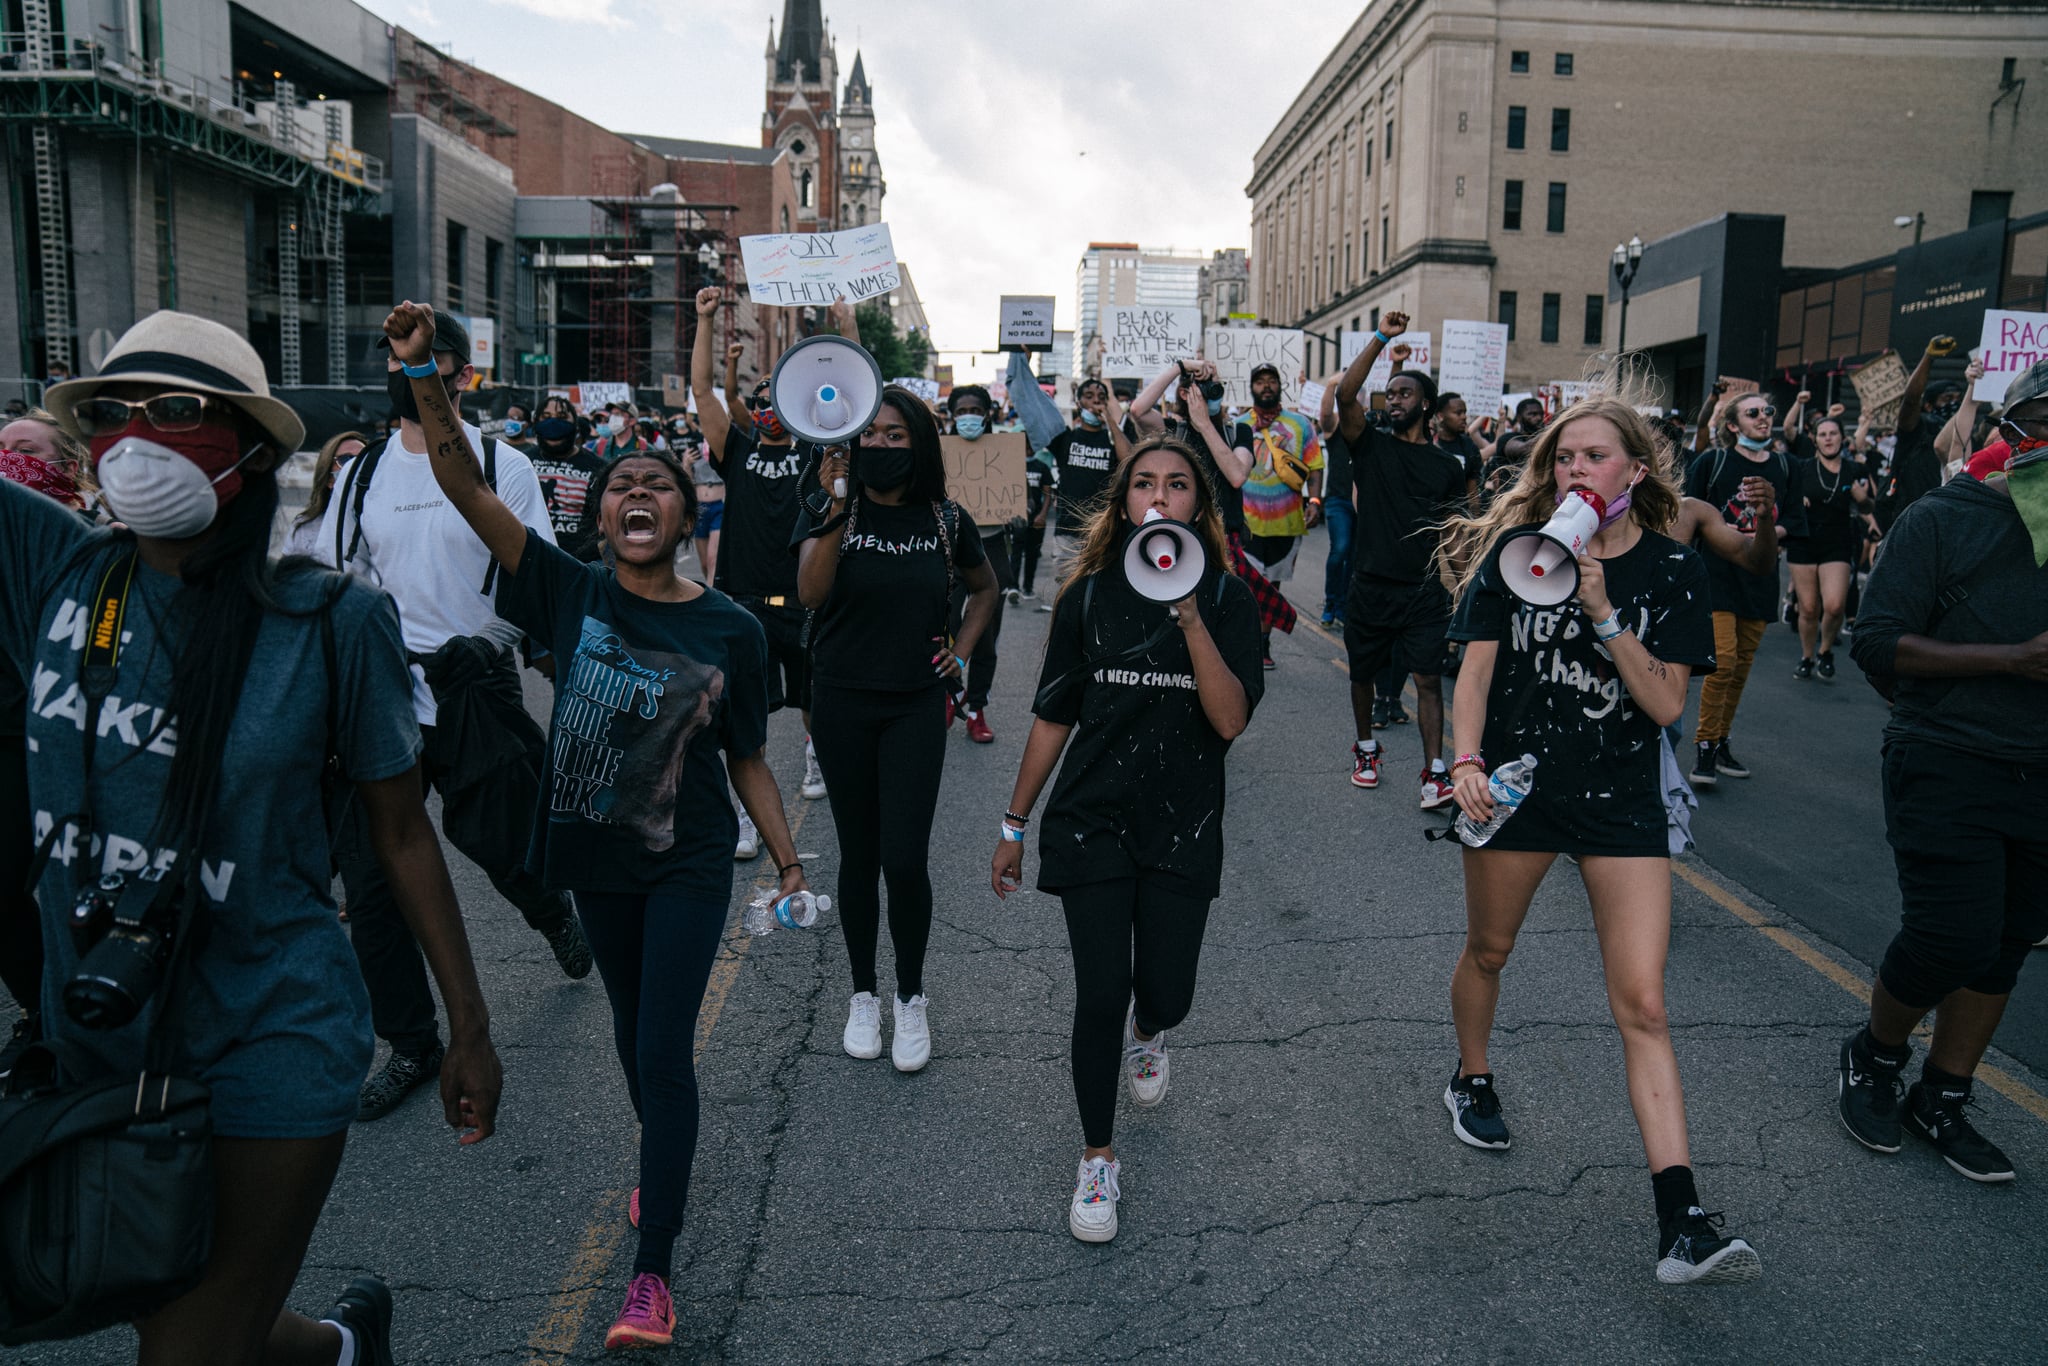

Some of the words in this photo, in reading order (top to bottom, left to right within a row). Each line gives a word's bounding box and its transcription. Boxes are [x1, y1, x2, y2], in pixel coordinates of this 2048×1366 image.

[789, 234, 838, 256] SAY
[768, 281, 842, 302] THEIR
[847, 271, 898, 297] NAMES
[1117, 310, 1178, 327] BLACK
[1112, 332, 1193, 353] MATTER!
[1216, 332, 1300, 363] BLACK
[1106, 354, 1134, 367] FUCK
[1137, 353, 1160, 365] THE
[943, 449, 1002, 481] UCK
[394, 500, 444, 512] PLACES+FACES
[95, 598, 118, 649] Nikon
[617, 649, 677, 681] Perry's
[1107, 669, 1139, 685] NEED
[573, 653, 664, 720] WHAT'S
[558, 690, 616, 744] DONE
[573, 739, 624, 787] THE
